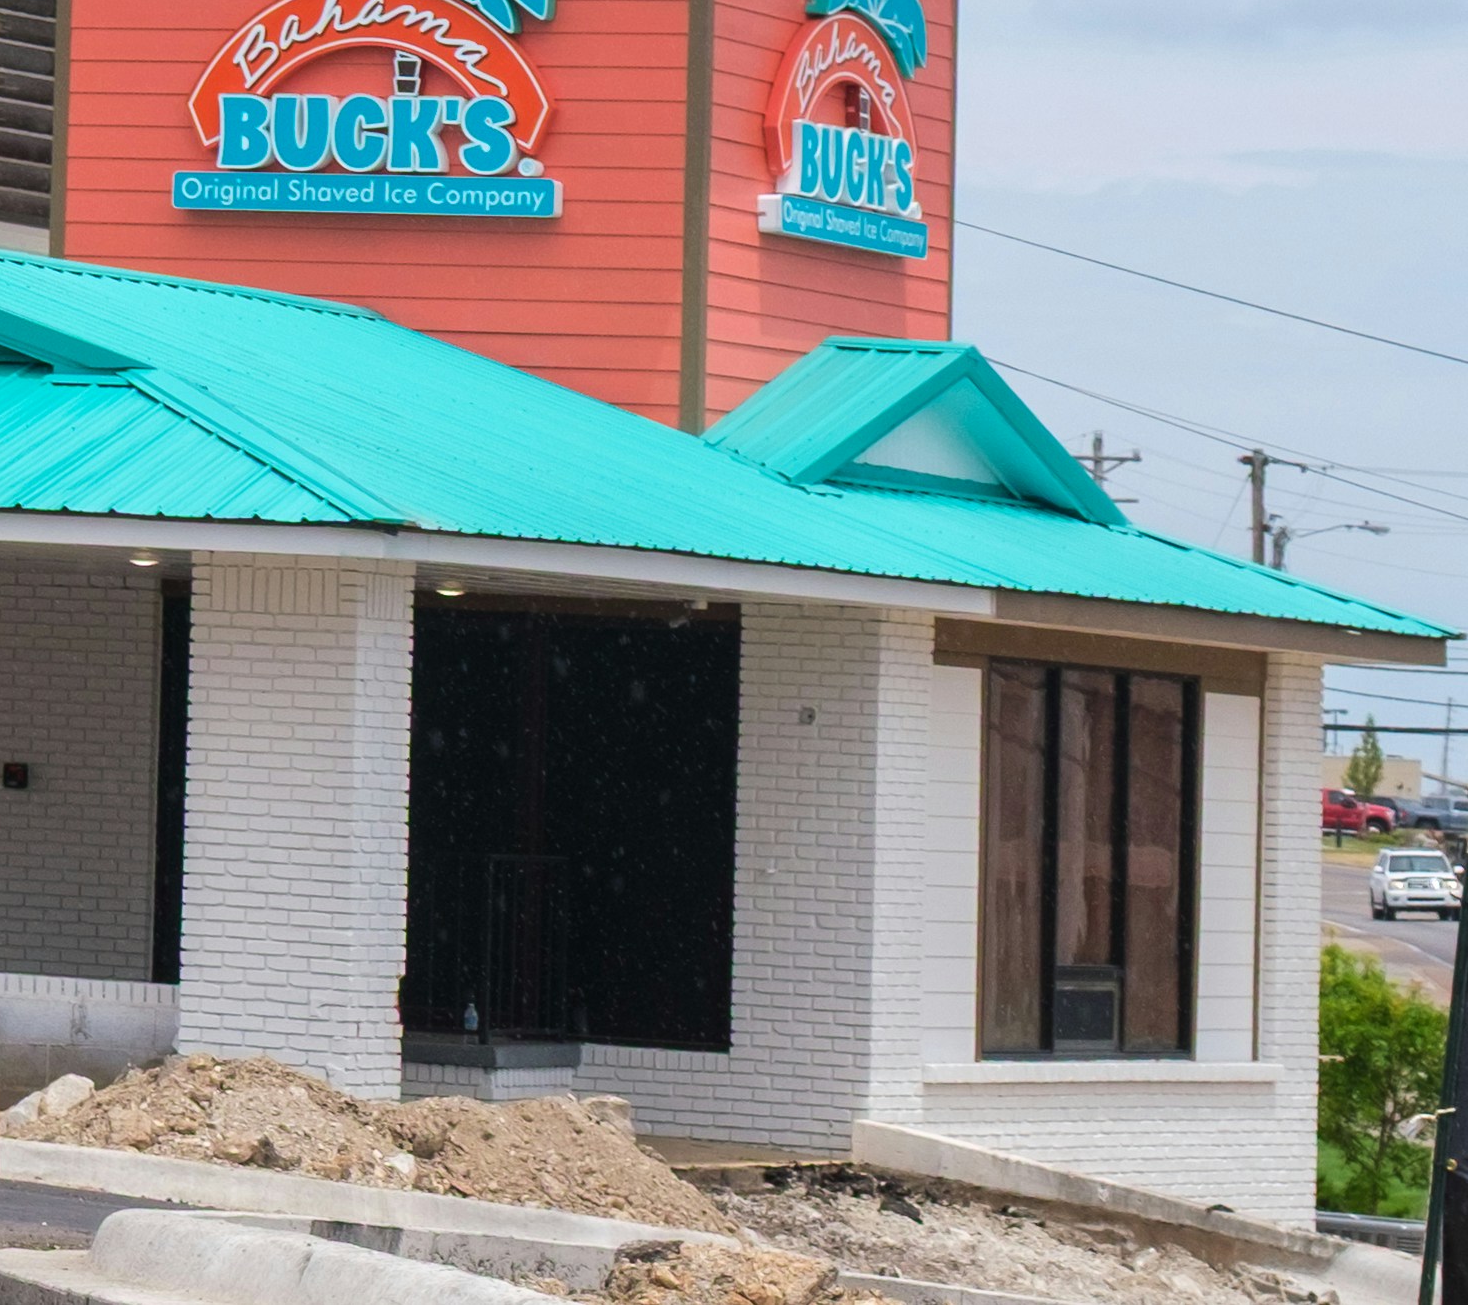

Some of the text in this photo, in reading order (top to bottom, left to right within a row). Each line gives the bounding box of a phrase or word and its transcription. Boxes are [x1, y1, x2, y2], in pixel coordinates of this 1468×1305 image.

[795, 21, 903, 139] Bahama
[217, 93, 518, 175] BUCK'S
[798, 123, 914, 216] BUCK'S
[181, 177, 547, 211] Original Shaved Ice Company
[783, 204, 925, 250] Original Shaved Ice Company
